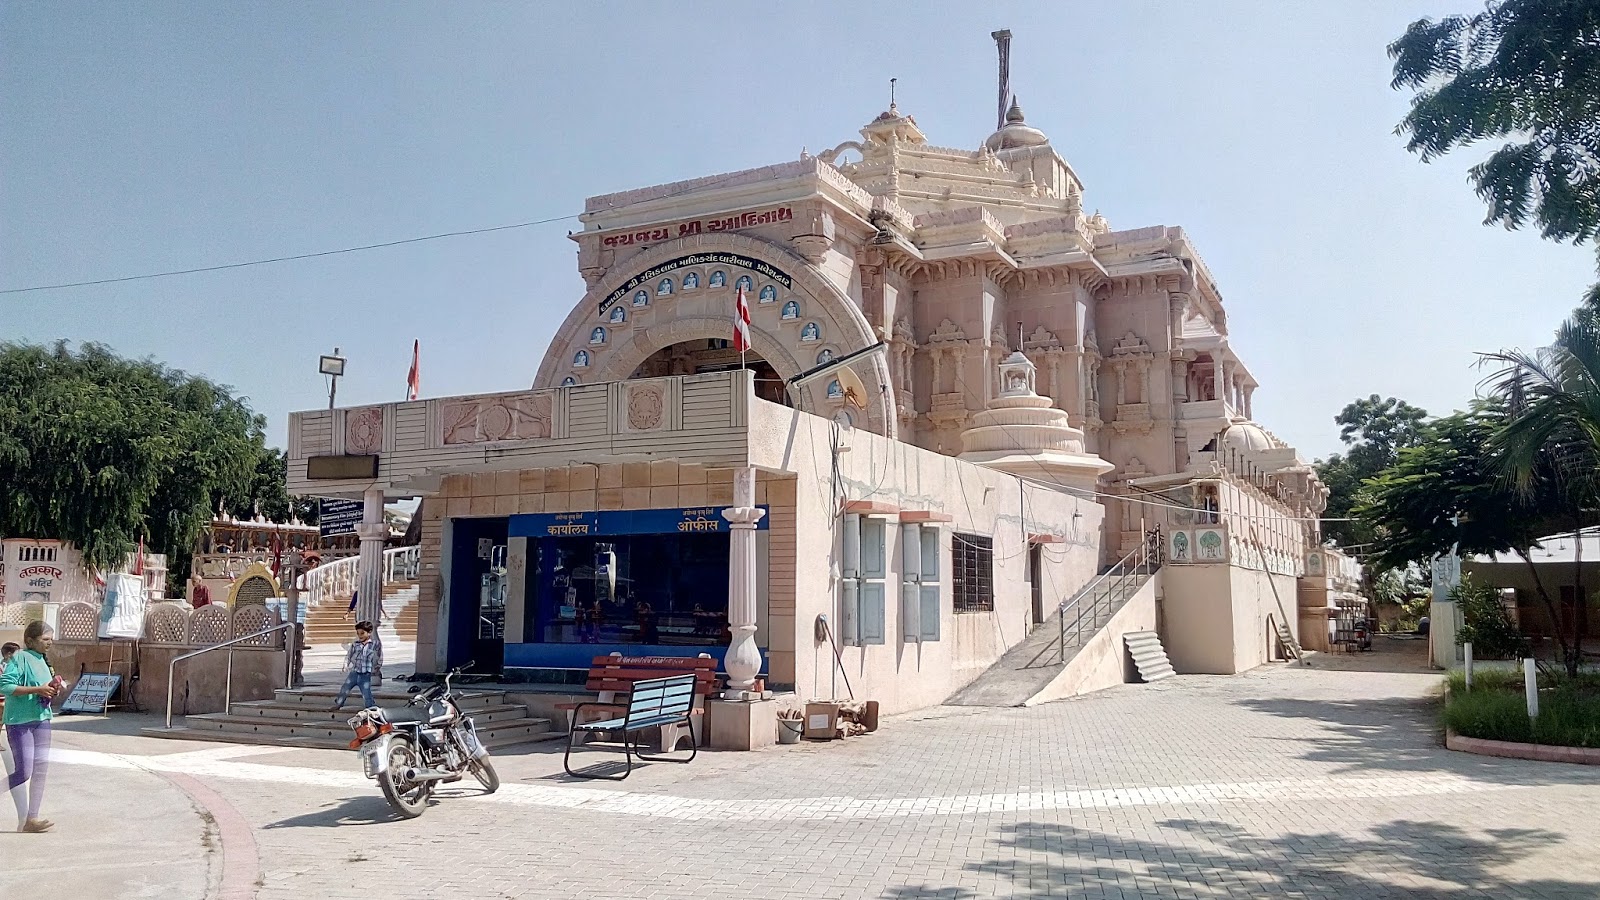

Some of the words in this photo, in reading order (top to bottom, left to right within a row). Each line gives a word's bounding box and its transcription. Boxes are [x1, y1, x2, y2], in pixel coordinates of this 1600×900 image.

[707, 207, 793, 232] આદિનાથ
[547, 520, 589, 536] कार्यालय
[677, 516, 719, 532] ओफीस
[19, 565, 63, 581] नवकार
[29, 577, 53, 589] मंदिर
